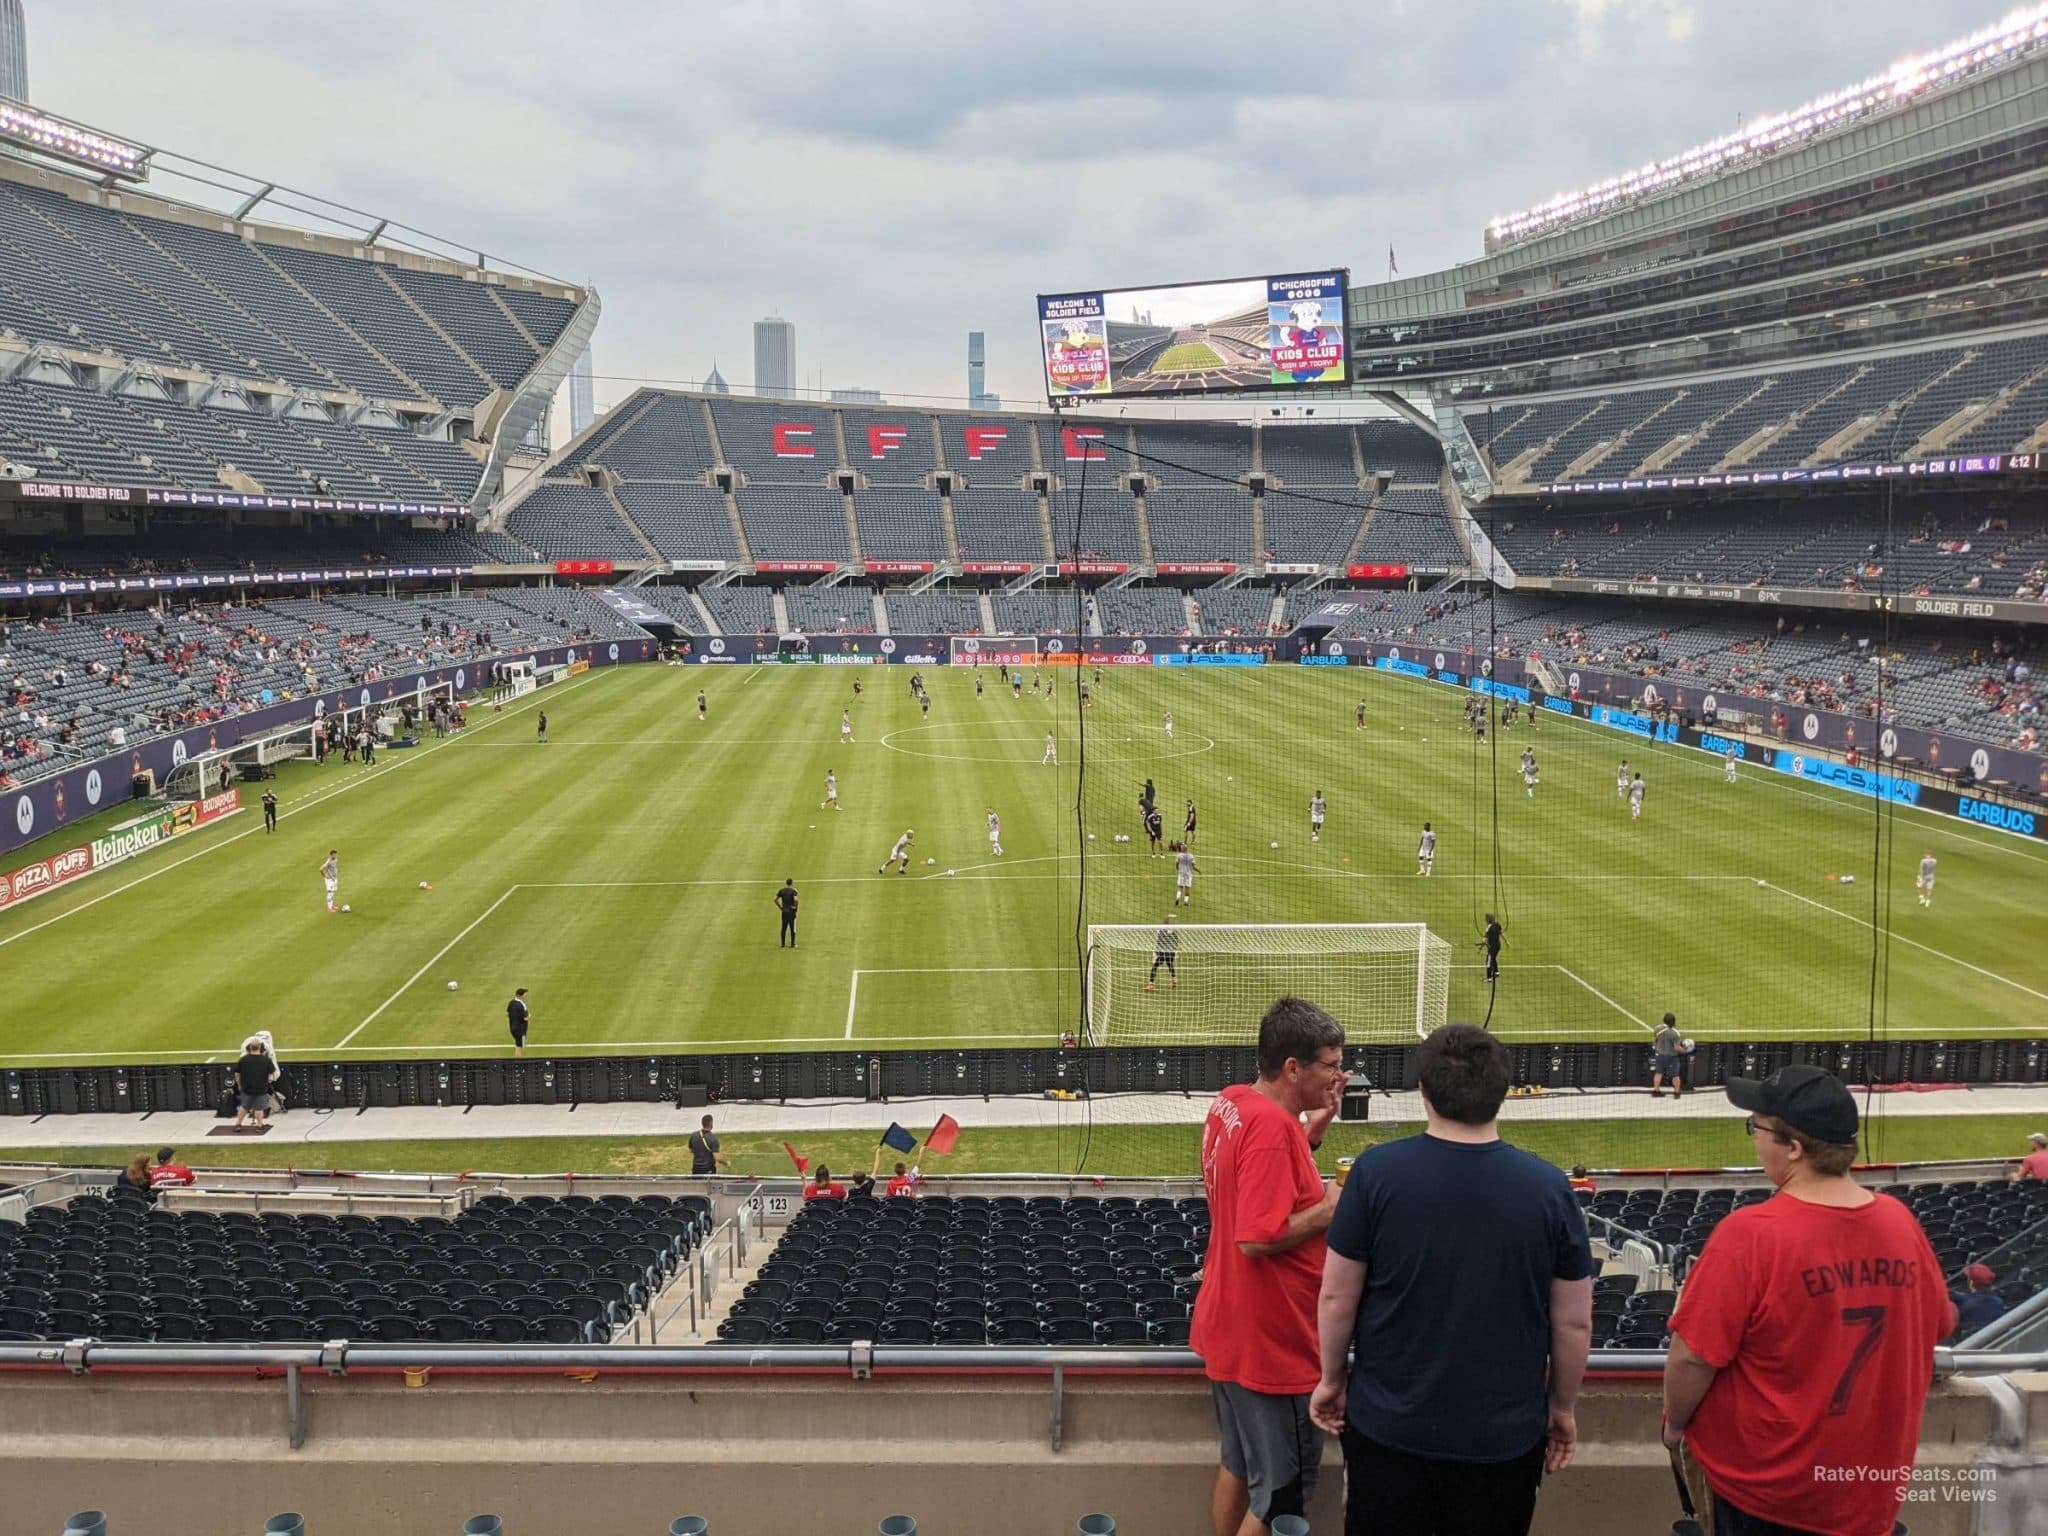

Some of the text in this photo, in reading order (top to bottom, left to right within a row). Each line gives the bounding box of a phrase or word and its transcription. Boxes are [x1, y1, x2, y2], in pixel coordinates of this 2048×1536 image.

[1048, 298, 1097, 309] WELCOME TO
[1046, 307, 1100, 318] SOLDIER FIELD
[1277, 346, 1337, 360] KIDS CLUB
[1052, 361, 1104, 374] KIDS CLUB
[1929, 460, 1944, 473] CHI
[1949, 459, 1956, 472] 0
[1966, 458, 1984, 471] ORL
[1989, 456, 1996, 470] 0
[2009, 455, 2030, 469] 4:12
[21, 483, 130, 501] WELCOME TO SOLDIER FIELD
[1915, 600, 1994, 616] SOLDIER FIELD
[823, 653, 874, 664] Heineken
[904, 654, 936, 663] Gillette
[1300, 655, 1348, 665] EARBUDS
[1544, 695, 1573, 714] EARBUDS
[1958, 795, 2035, 834] EARBUDS
[91, 823, 160, 867] Heineken
[14, 865, 50, 895] PIZZA
[54, 849, 88, 878] PUFF
[86, 1187, 103, 1197] 125
[770, 1198, 787, 1210] 123
[1802, 1257, 1918, 1298] EDWARDS
[1827, 1305, 1887, 1416] 7
